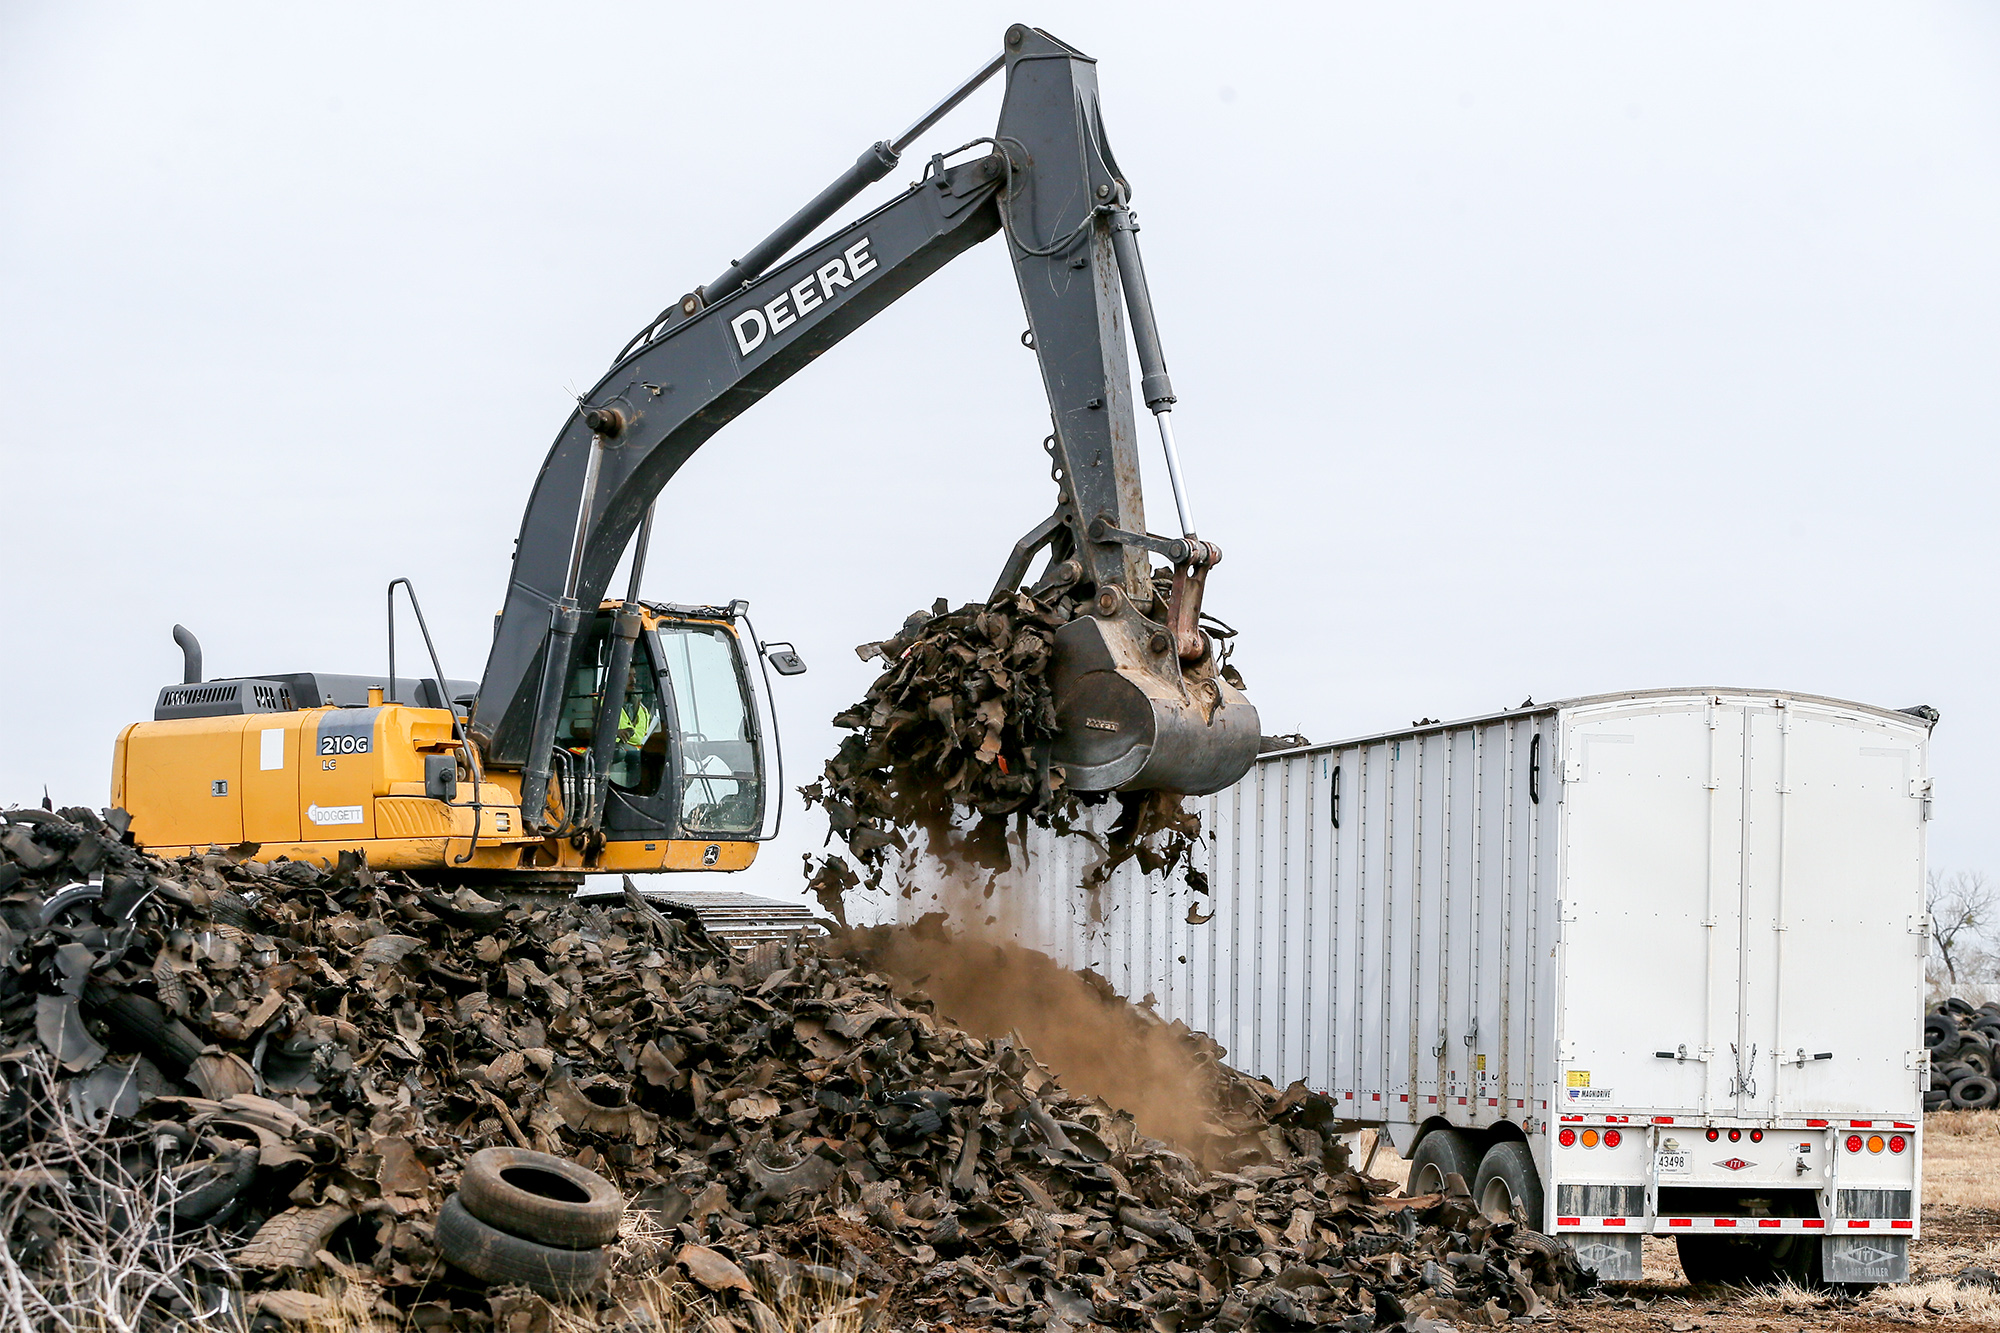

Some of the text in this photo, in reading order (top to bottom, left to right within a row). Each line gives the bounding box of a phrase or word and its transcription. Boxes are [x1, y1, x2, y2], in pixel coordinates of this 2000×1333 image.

[730, 236, 879, 357] DEERE
[322, 735, 368, 755] 210G
[322, 759, 337, 770] LC
[317, 809, 361, 821] DOGGETT
[1659, 1156, 1685, 1168] 43498
